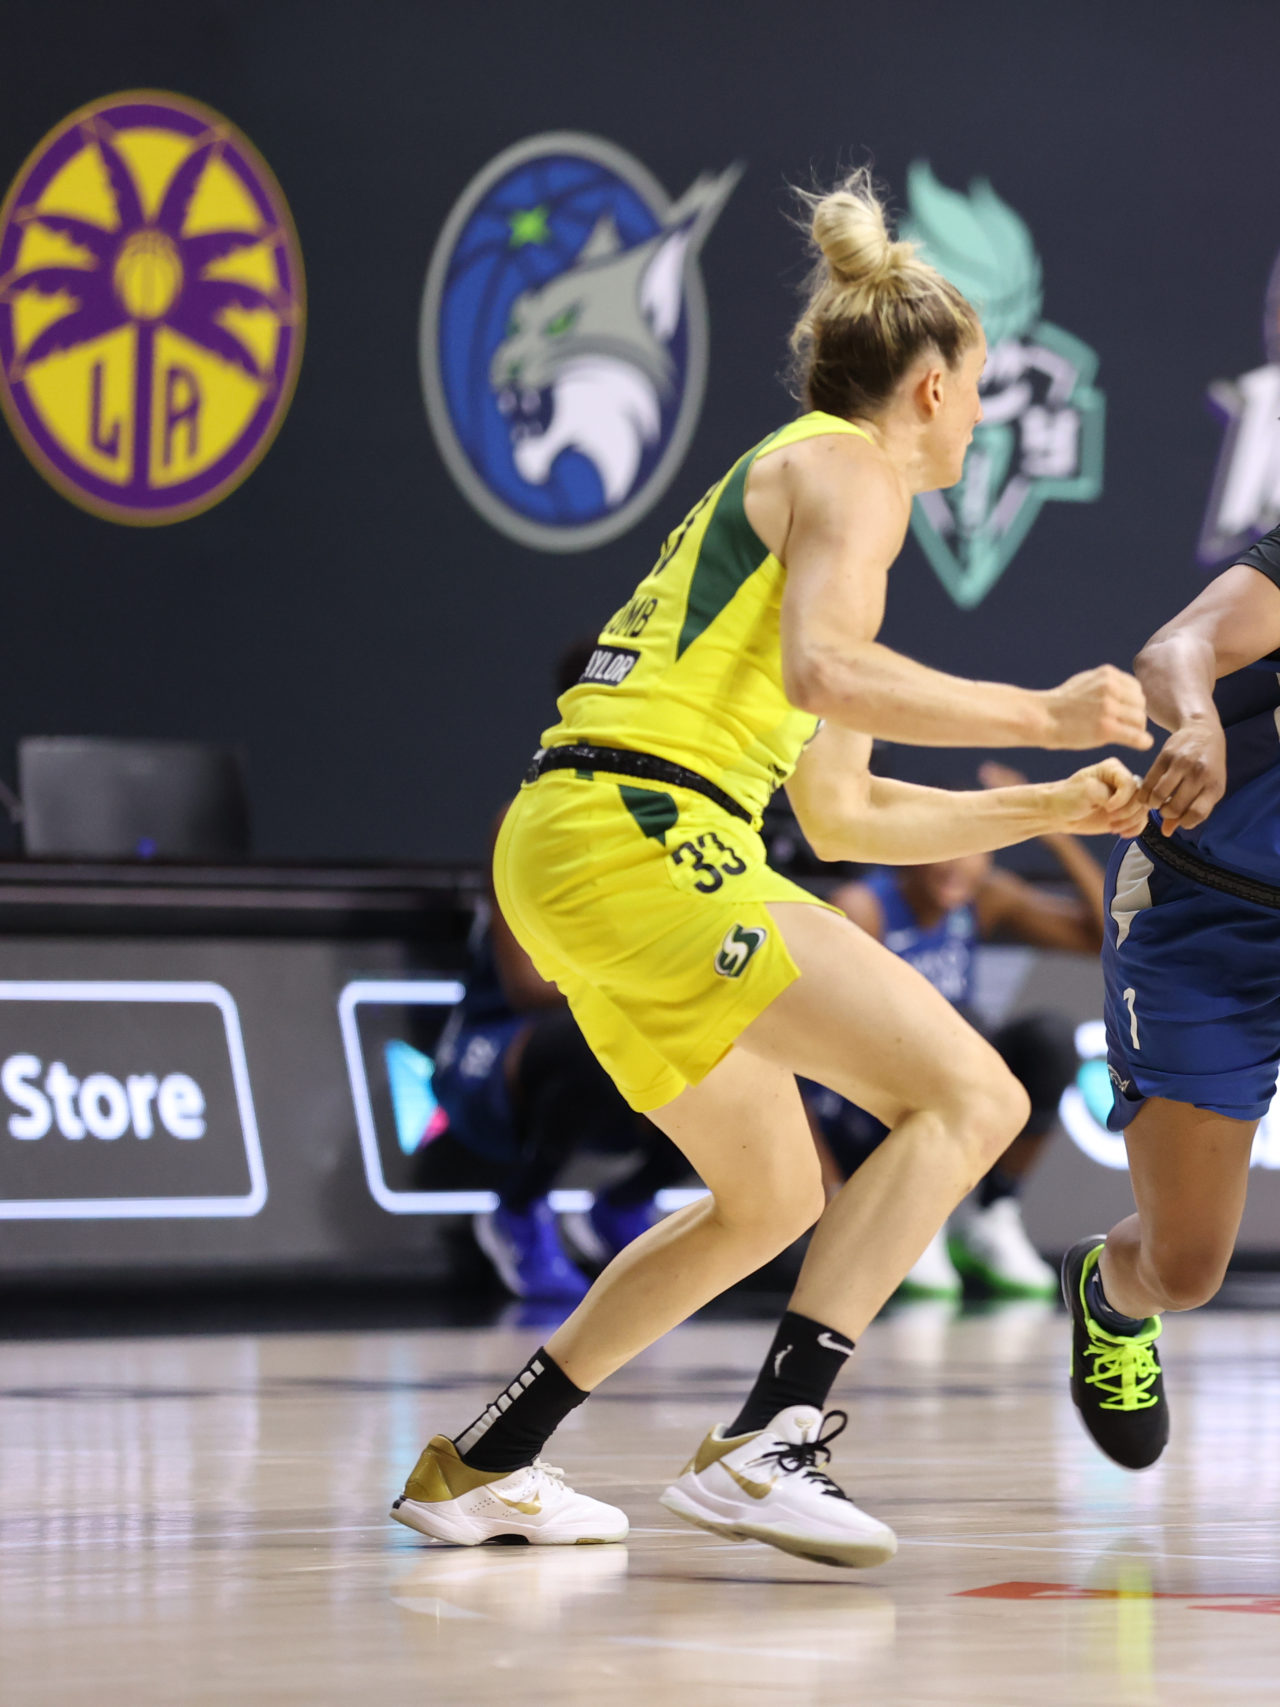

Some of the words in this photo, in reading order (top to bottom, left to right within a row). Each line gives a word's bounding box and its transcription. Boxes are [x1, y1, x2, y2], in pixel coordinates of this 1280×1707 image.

[671, 832, 747, 894] 33
[1123, 987, 1140, 1050] 1
[1, 1052, 206, 1140] Store
